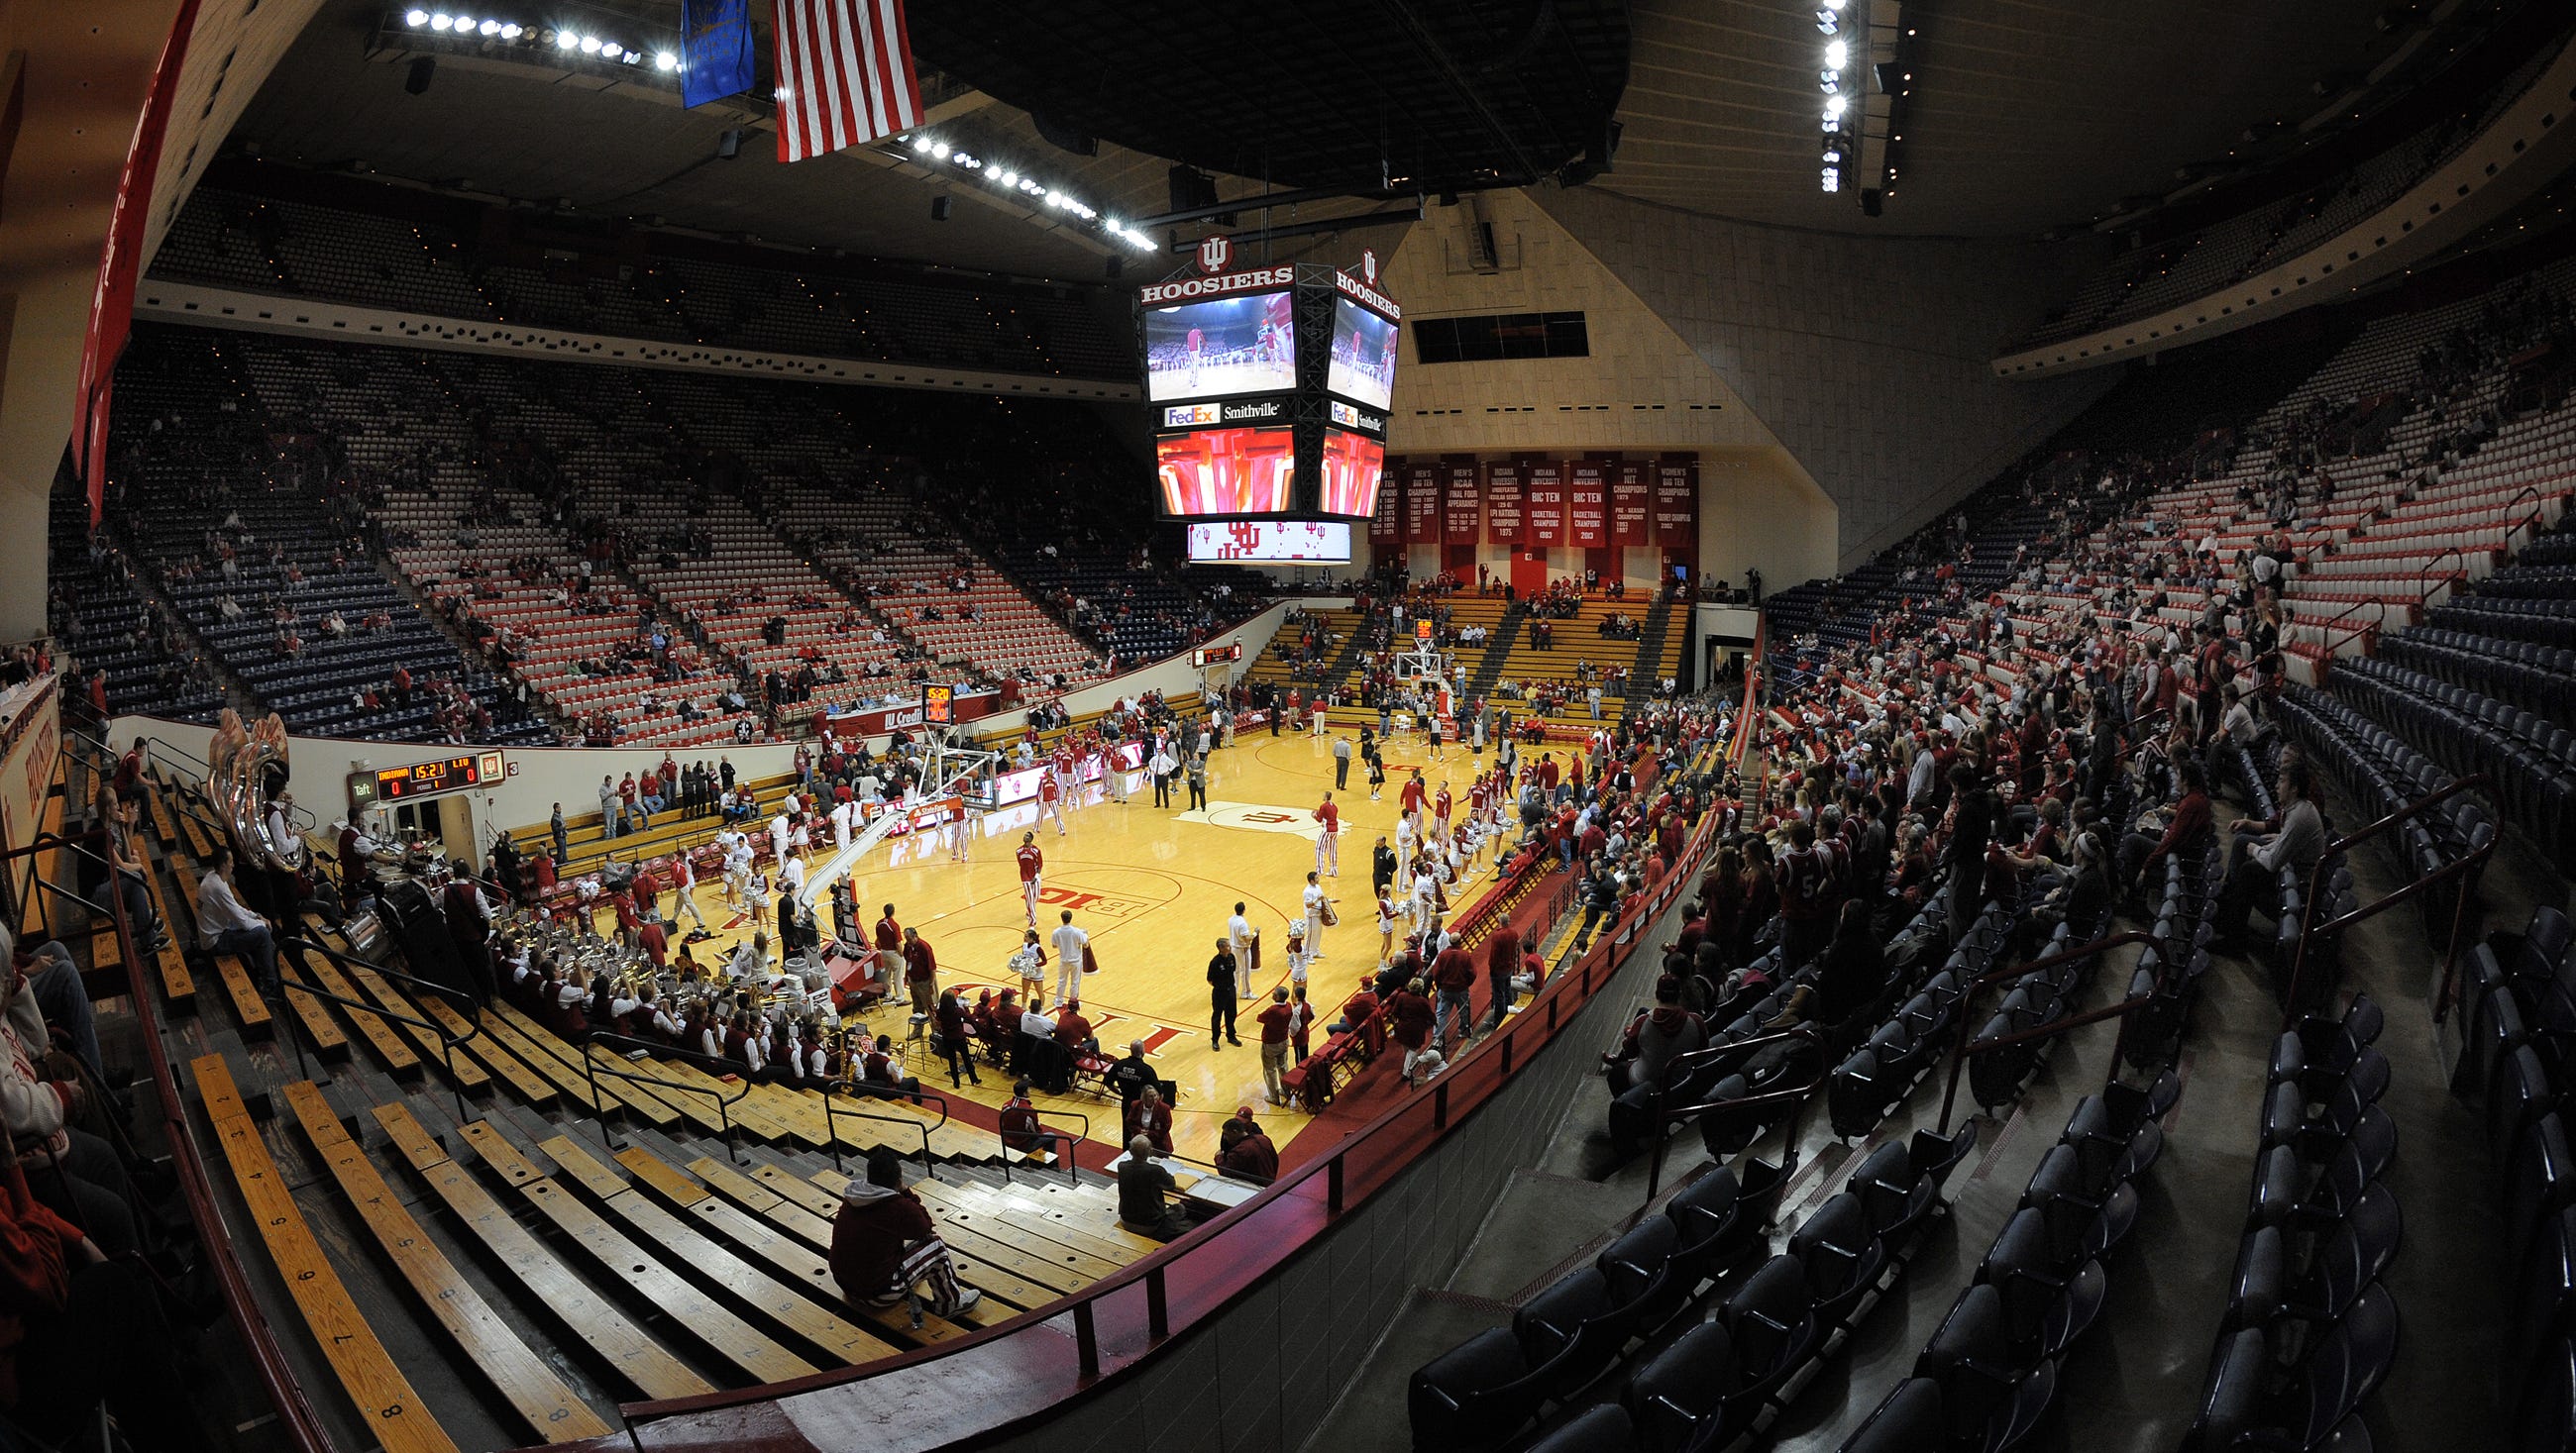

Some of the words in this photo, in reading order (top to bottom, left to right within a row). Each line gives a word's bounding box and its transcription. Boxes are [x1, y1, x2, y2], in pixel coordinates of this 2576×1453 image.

[1141, 266, 1294, 303] HOOSIERS
[1337, 270, 1400, 320] HOOSIERS
[1168, 407, 1214, 425] FedEx
[1225, 402, 1278, 420] Smithville
[1334, 404, 1355, 425] FedEx
[1494, 467, 1515, 476] INDIANA
[1661, 467, 1687, 476] WOMEN'S
[1453, 478, 1473, 488] NCAA
[1490, 477, 1518, 486] UNIVERSITY
[1624, 475, 1637, 484] NIT
[1674, 477, 1684, 486] TEN
[1613, 484, 1648, 493] CHAMPIONS
[1658, 487, 1690, 496] CHAMPIONS
[1532, 492, 1544, 503] BIG
[1545, 492, 1560, 503] TEN
[1573, 492, 1586, 503] BIG
[1587, 492, 1602, 503] TEN
[1499, 508, 1522, 517] NATIONAL
[1572, 510, 1602, 519] BASKETBALL
[1492, 518, 1520, 527] CHAMPIONS
[1499, 528, 1512, 537] 1975
[928, 687, 949, 700] 15:20
[885, 712, 896, 729] IU
[896, 707, 922, 726] Credi
[453, 759, 470, 768] LIU
[377, 768, 409, 781] INDIANA
[415, 764, 443, 779] 15:21
[467, 769, 474, 781] 0
[509, 765, 517, 775] 3
[354, 783, 372, 796] Taft
[391, 781, 400, 795] 0
[876, 813, 908, 841] INDIANA
[1802, 875, 1814, 899] 5
[1117, 1071, 1142, 1082] SECURITY
[270, 1217, 287, 1226] 5
[381, 1404, 402, 1418] 8
[549, 1408, 570, 1421] 8
